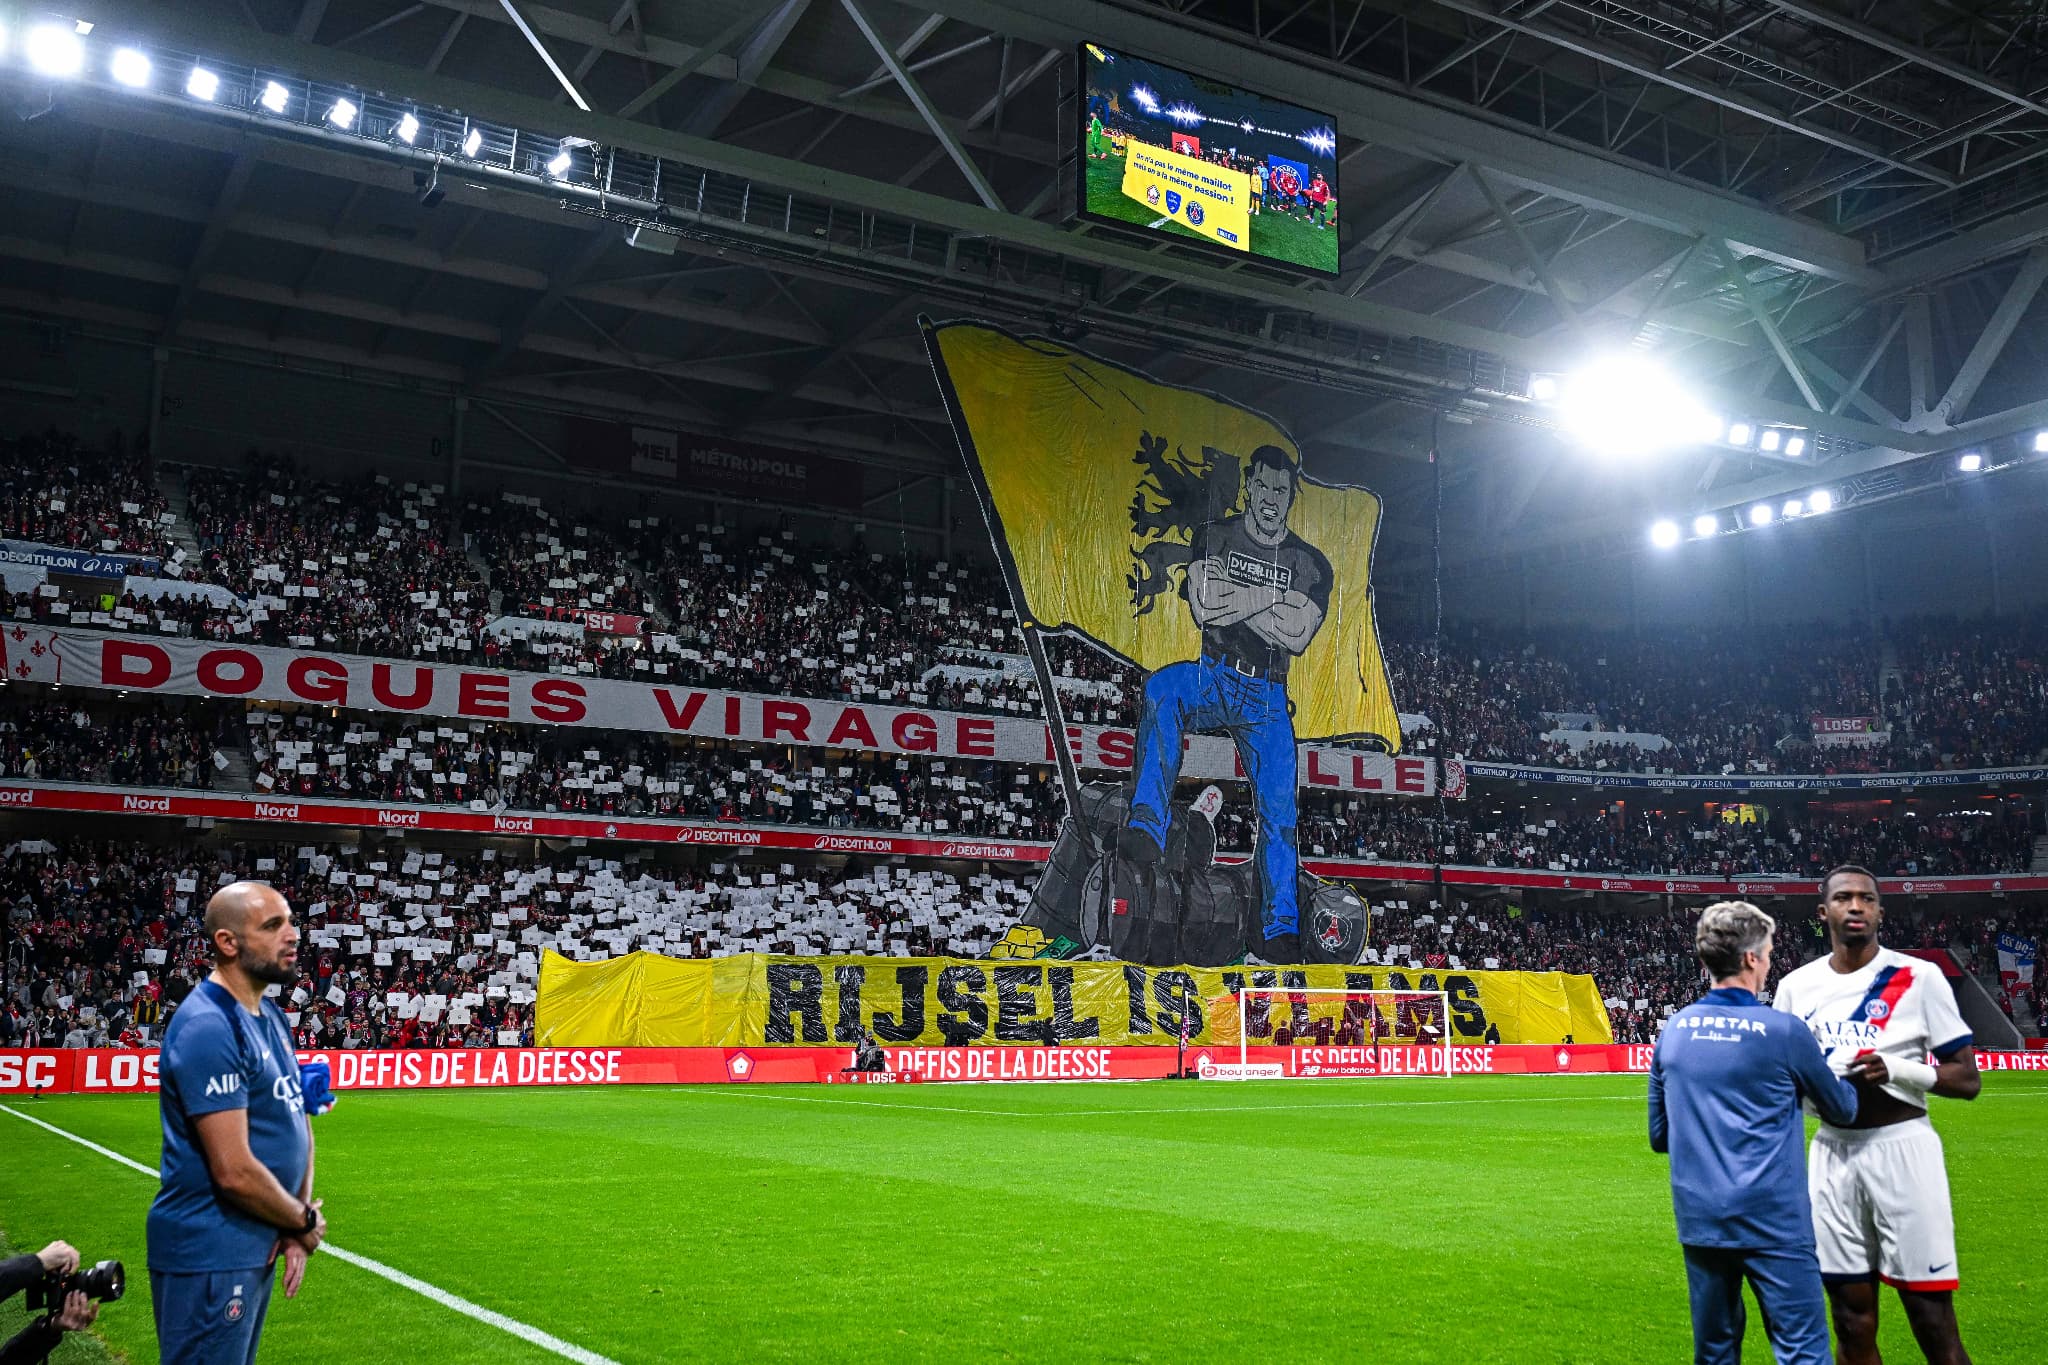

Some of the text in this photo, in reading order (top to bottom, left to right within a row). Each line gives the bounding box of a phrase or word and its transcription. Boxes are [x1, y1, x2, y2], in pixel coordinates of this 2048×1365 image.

[1134, 162, 1146, 171] mais
[1148, 167, 1156, 175] on
[1169, 176, 1193, 189] même
[1194, 185, 1228, 203] passion
[1155, 160, 1166, 169] pas
[1167, 163, 1174, 171] le
[1175, 167, 1199, 180] même
[1201, 175, 1232, 191] maillot
[632, 441, 677, 464] MEL
[691, 448, 807, 479] MÉTROPOLE
[0, 551, 77, 569] DECATHLON
[101, 639, 587, 723] DOGUES
[652, 688, 995, 757] VIRAGE
[1823, 719, 1862, 731] LOSC
[1473, 767, 1543, 780] DECATHLON ARENA
[1556, 774, 1632, 786] DECATHLON ARENA
[1861, 775, 1959, 787] DECATHLON ARENA
[1979, 771, 2029, 782] DECATHLON
[1648, 779, 1732, 789] DECATHLON ARENA
[1750, 780, 1842, 789] DECATHLON ARENA
[0, 790, 33, 802] ord
[123, 796, 170, 811] Nord
[255, 803, 298, 818] Nord
[378, 810, 419, 825] Nord
[494, 816, 533, 831] Nord
[694, 830, 760, 844] DECATHLON
[830, 837, 891, 851] DECATHLON
[957, 844, 1014, 858] DECATHLON
[764, 963, 1100, 1043] RIJSEL
[1124, 966, 1204, 1038] IS
[1676, 1016, 1767, 1037] ASPETAR
[1823, 1021, 1878, 1039] ATAR
[899, 1046, 961, 1079] DÉFIS
[967, 1049, 995, 1078] DE
[1000, 1049, 1025, 1077] LA
[1032, 1045, 1111, 1077] DÉESSE
[1381, 1048, 1402, 1072] DE
[1407, 1048, 1427, 1072] LA
[1629, 1046, 1653, 1070] LES
[2012, 1053, 2048, 1070] DÉES
[0, 1055, 55, 1088] SC
[85, 1055, 160, 1087] LOS
[338, 1047, 622, 1087] DÉFIS DE LA DÉESSE
[1220, 1068, 1278, 1077] bouanger
[1340, 1066, 1376, 1074] balance
[867, 1073, 896, 1083] LOSC
